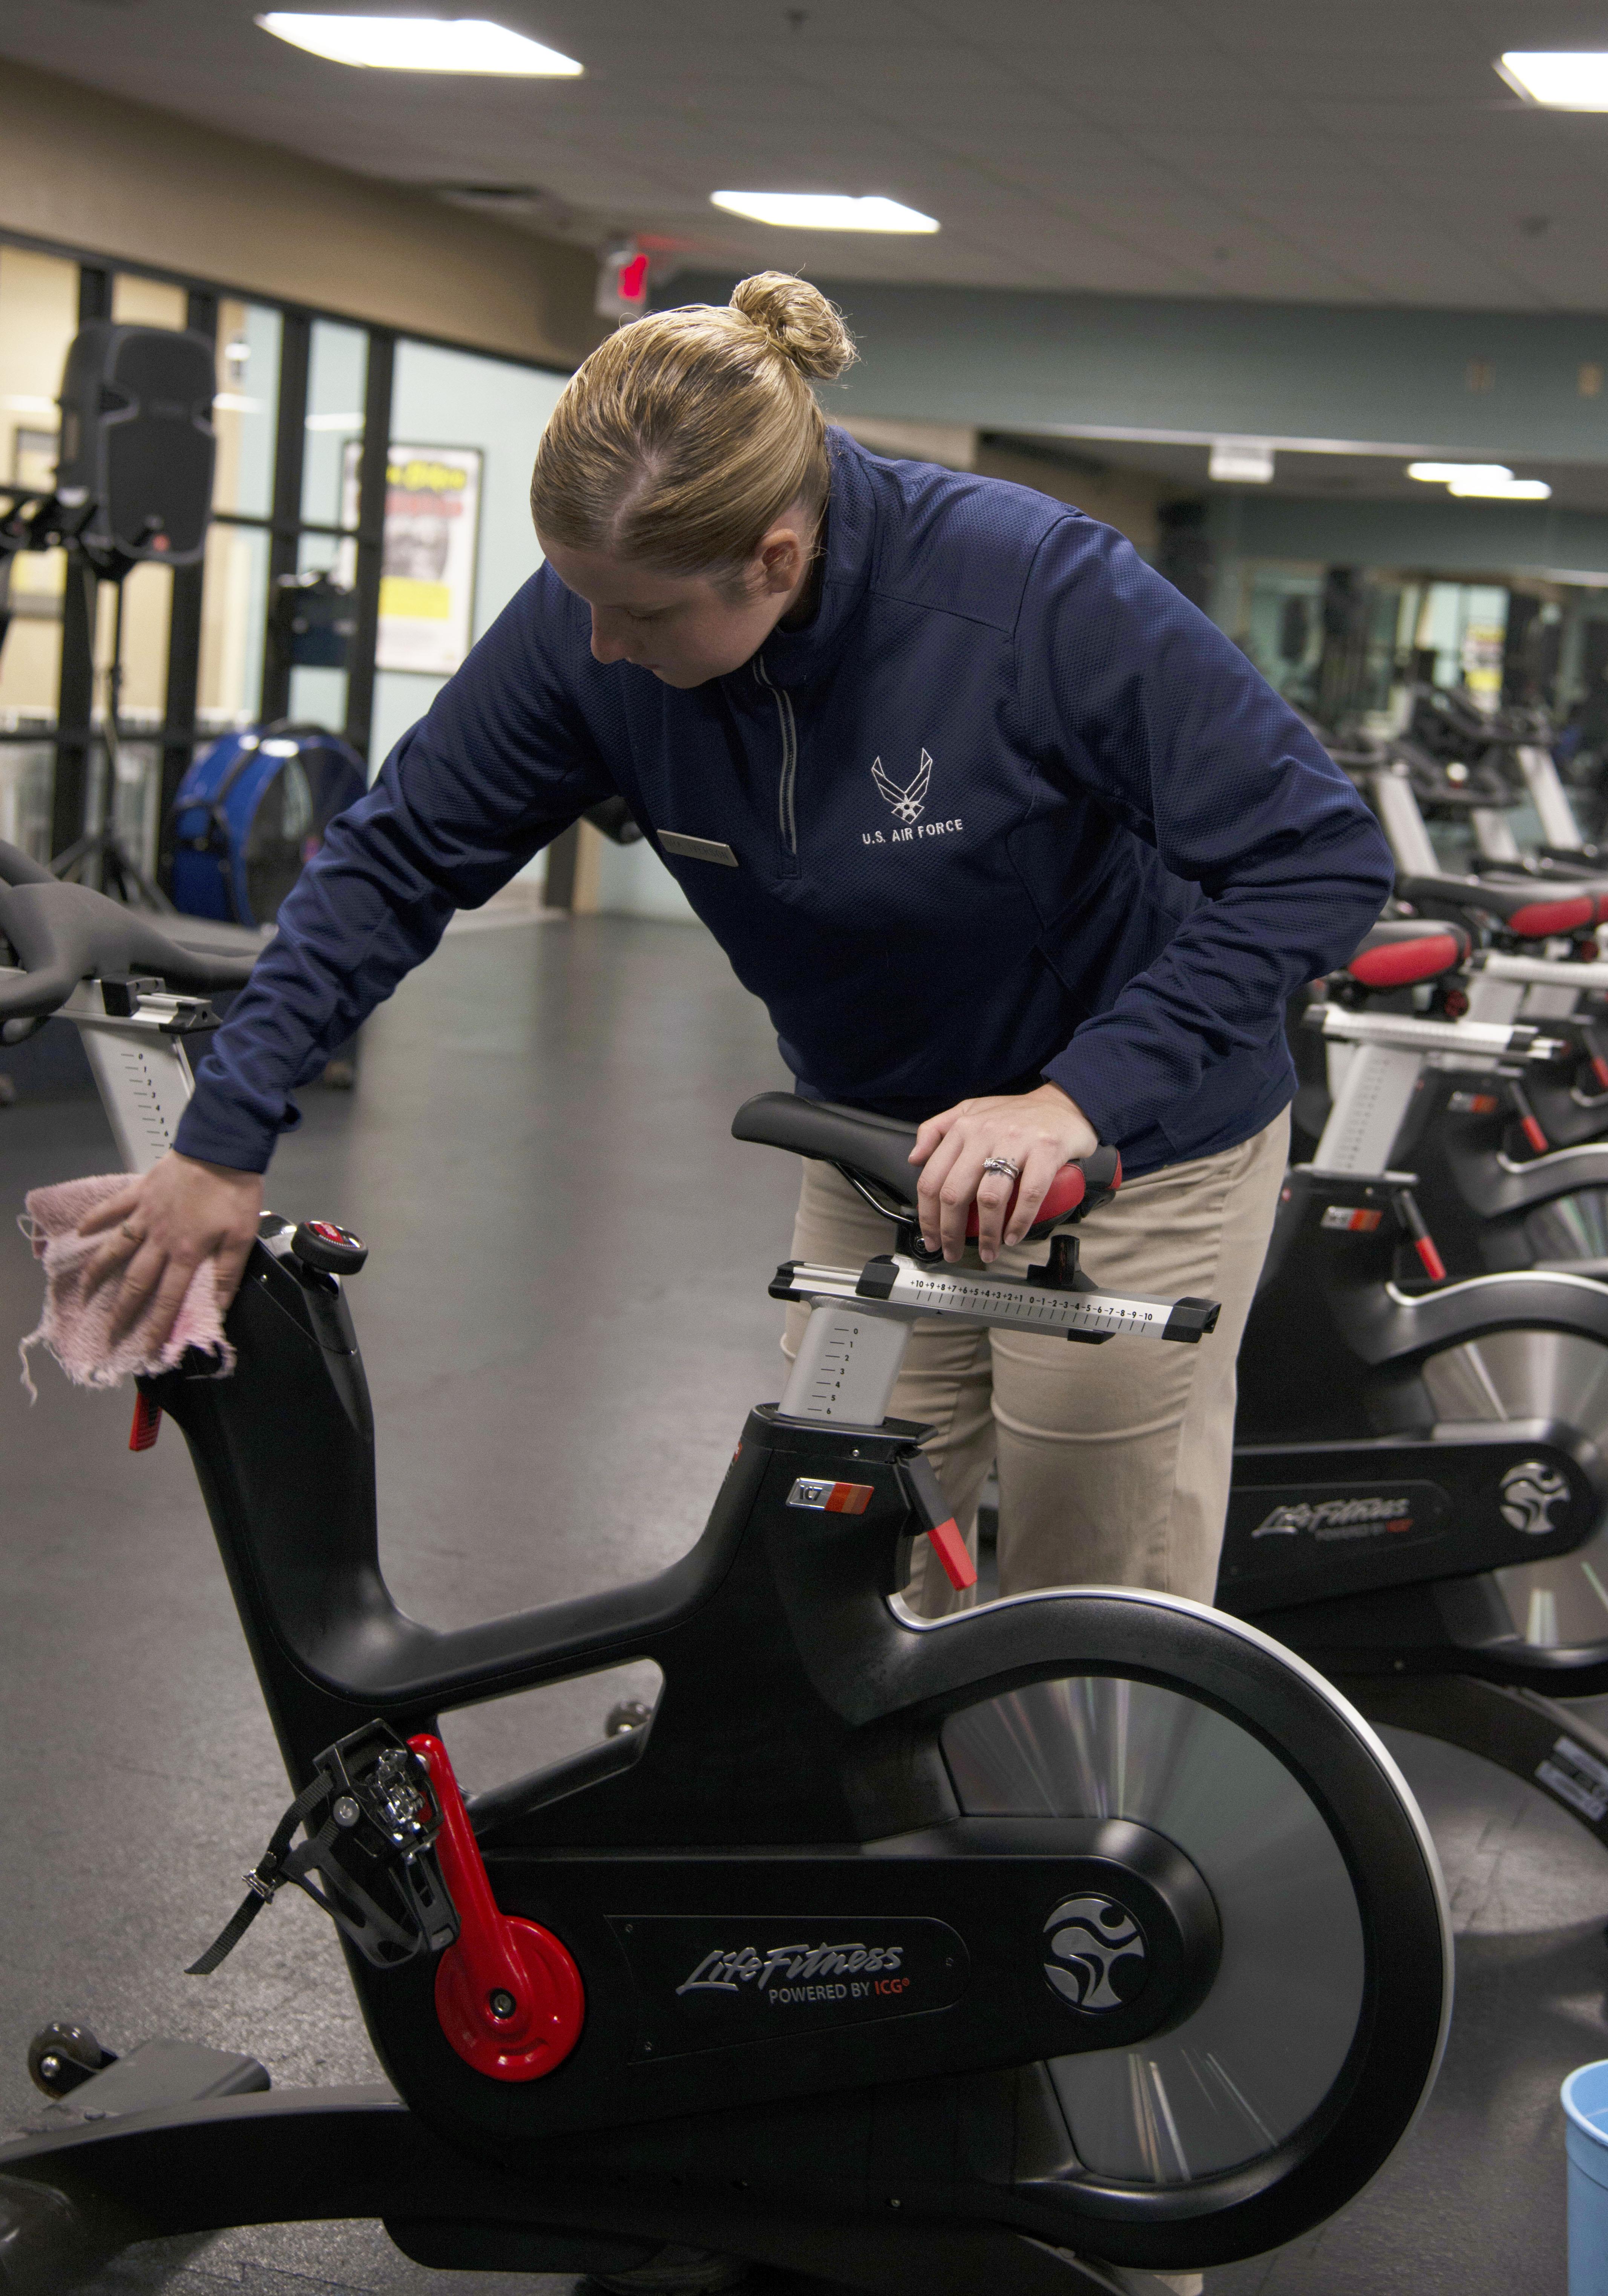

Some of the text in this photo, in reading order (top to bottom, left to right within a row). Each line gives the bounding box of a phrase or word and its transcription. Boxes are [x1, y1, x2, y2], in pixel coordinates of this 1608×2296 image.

[862, 819, 963, 844] U.S. AIR FORCE
[800, 1485, 823, 1501] IC7
[768, 1984, 847, 2004] POWERED
[851, 1981, 870, 1997] BY
